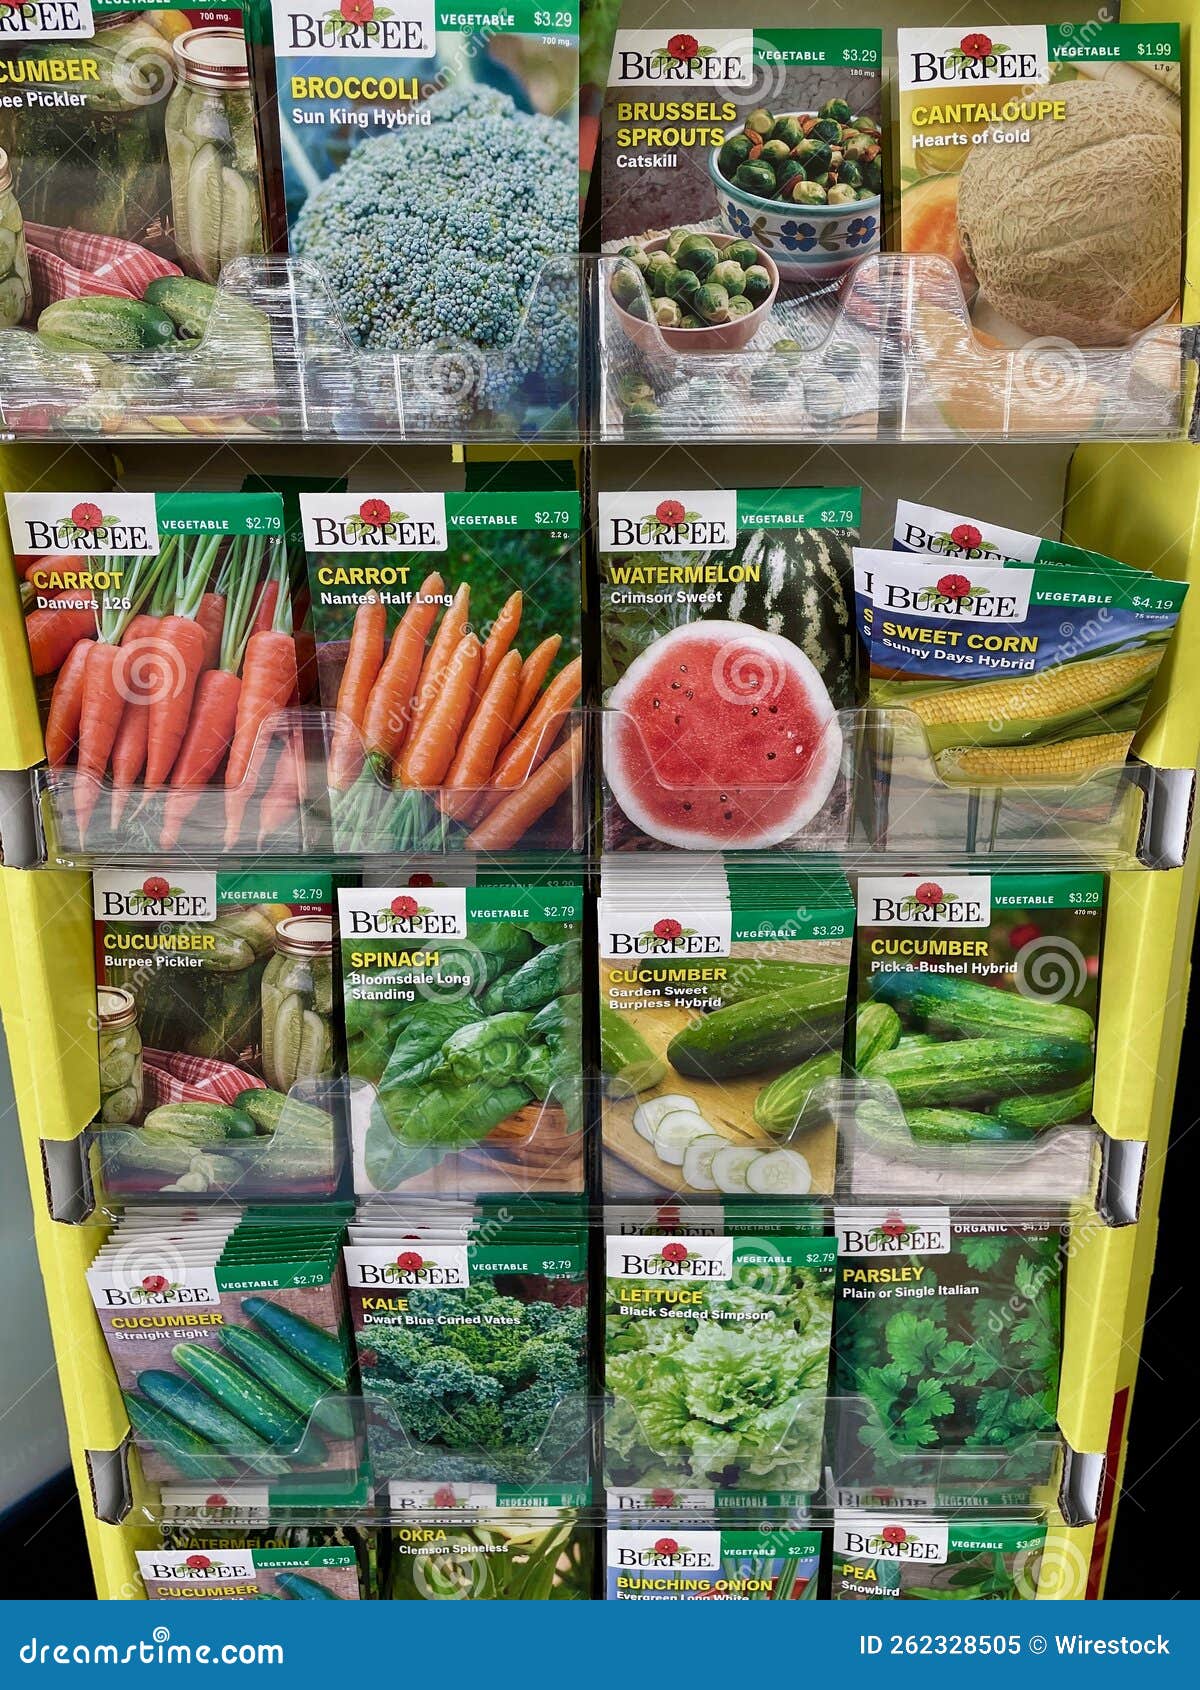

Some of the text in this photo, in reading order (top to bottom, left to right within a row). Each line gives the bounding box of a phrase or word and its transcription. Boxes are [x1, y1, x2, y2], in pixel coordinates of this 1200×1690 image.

[200, 12, 214, 20] 700
[441, 14, 515, 26] VEGETABLE
[534, 11, 572, 27] $3.29
[287, 14, 423, 49] BURPEE
[542, 36, 557, 45] 700
[758, 51, 825, 61] VEGETABLE
[842, 49, 877, 63] $3.29
[1053, 46, 1120, 57] VEGETABLE
[1137, 43, 1171, 57] $1.99
[618, 51, 742, 80] BURPEE
[911, 52, 1038, 83] BURPEE
[291, 76, 419, 101] BROCCOLI
[26, 91, 87, 107] Pickler
[292, 108, 432, 128] Sun King Hybrid
[617, 102, 737, 122] BRUSSELS
[912, 101, 1066, 126] CANTALOUPE
[616, 127, 725, 147] SPROUTS
[912, 129, 1030, 149] Hearts of Gold
[616, 154, 677, 168] Catskill
[246, 517, 281, 530] $2.79
[451, 515, 518, 525] VEGETABLE
[534, 511, 569, 524] $2.79
[741, 514, 805, 524] VEGETABLE
[820, 511, 853, 523] $2.79
[162, 520, 229, 530] VEGETABLE
[312, 517, 436, 546] BURPEE
[610, 518, 726, 546] BURPEE
[25, 521, 148, 550] BURPEE
[33, 571, 124, 590] CARROT
[318, 567, 410, 586] CARROT
[610, 565, 760, 584] WATERMELON
[37, 596, 131, 610] Danvers 126
[320, 591, 453, 607] Nantes Half Long
[610, 591, 722, 604] Crimson Sweet
[885, 584, 1016, 617] BURPEE
[1036, 591, 1112, 604] VEGETABLE
[1132, 596, 1173, 610] $4.19
[883, 621, 962, 647] SWEET
[967, 632, 1039, 654] CORN
[882, 638, 1036, 671] Sunny Days Hybrid
[221, 891, 278, 900] VEGETABLE
[292, 888, 323, 900] $2.79
[995, 896, 1054, 904] VEGETABLE
[1069, 892, 1099, 904] $3.29
[102, 891, 207, 916] BURPEE
[872, 898, 980, 923] BURPEE
[470, 909, 529, 918] VEGETABLE
[543, 906, 575, 917] $2.79
[349, 910, 458, 934] BURPEE
[736, 929, 797, 938] VEGETABLE
[812, 925, 844, 936] $3.29
[103, 934, 215, 950] CUCUMBER
[609, 933, 721, 955] BURPEE
[871, 939, 989, 957] CUCUMBER
[104, 954, 203, 969] Burpee Pickler
[351, 951, 439, 968] SPINACH
[609, 968, 728, 983] CUCUMBER
[871, 961, 1018, 977] Pick-a-Bushel Hybrid
[352, 973, 471, 986] Bloomsdale Long
[352, 989, 415, 1001] Standing
[609, 986, 708, 998] Garden Sweet
[609, 998, 722, 1010] Burpless Hybrid
[954, 1224, 1008, 1233] ORGANIC
[842, 1230, 943, 1252] BURPEE
[542, 1260, 571, 1270] $2.79
[621, 1255, 723, 1276] BURPEE
[806, 1254, 835, 1263] $2.79
[293, 1275, 324, 1285] $2.79
[358, 1264, 460, 1285] BURPEE
[843, 1266, 925, 1283] PARSLEY
[221, 1280, 279, 1290] VEGETABLE
[843, 1284, 980, 1300] Plain or Single Italian
[102, 1288, 212, 1306] BURPEE
[620, 1288, 703, 1304] LETTUCE
[362, 1297, 409, 1311] KALE
[363, 1314, 521, 1325] Dwarf Blue Curled Vates
[620, 1306, 769, 1320] Black Seeded Simpson
[111, 1314, 225, 1329] CUCUMBER
[115, 1328, 209, 1341] Straight Eight
[400, 1530, 447, 1542] OKRA
[399, 1544, 509, 1555] Clemson Spineless
[788, 1546, 815, 1555] $2.79
[844, 1532, 939, 1560] BURPEE
[952, 1540, 1003, 1549] VEGETABLE
[1016, 1538, 1041, 1549] $3.29
[322, 1557, 350, 1565] $2.79
[618, 1548, 711, 1568] BURPEE
[149, 1564, 248, 1579] BURPEE
[842, 1564, 878, 1582] PEA
[617, 1577, 773, 1592] BUNCHING ONION
[842, 1580, 900, 1598] Snowbird
[158, 1586, 259, 1598] CUCUMBER
